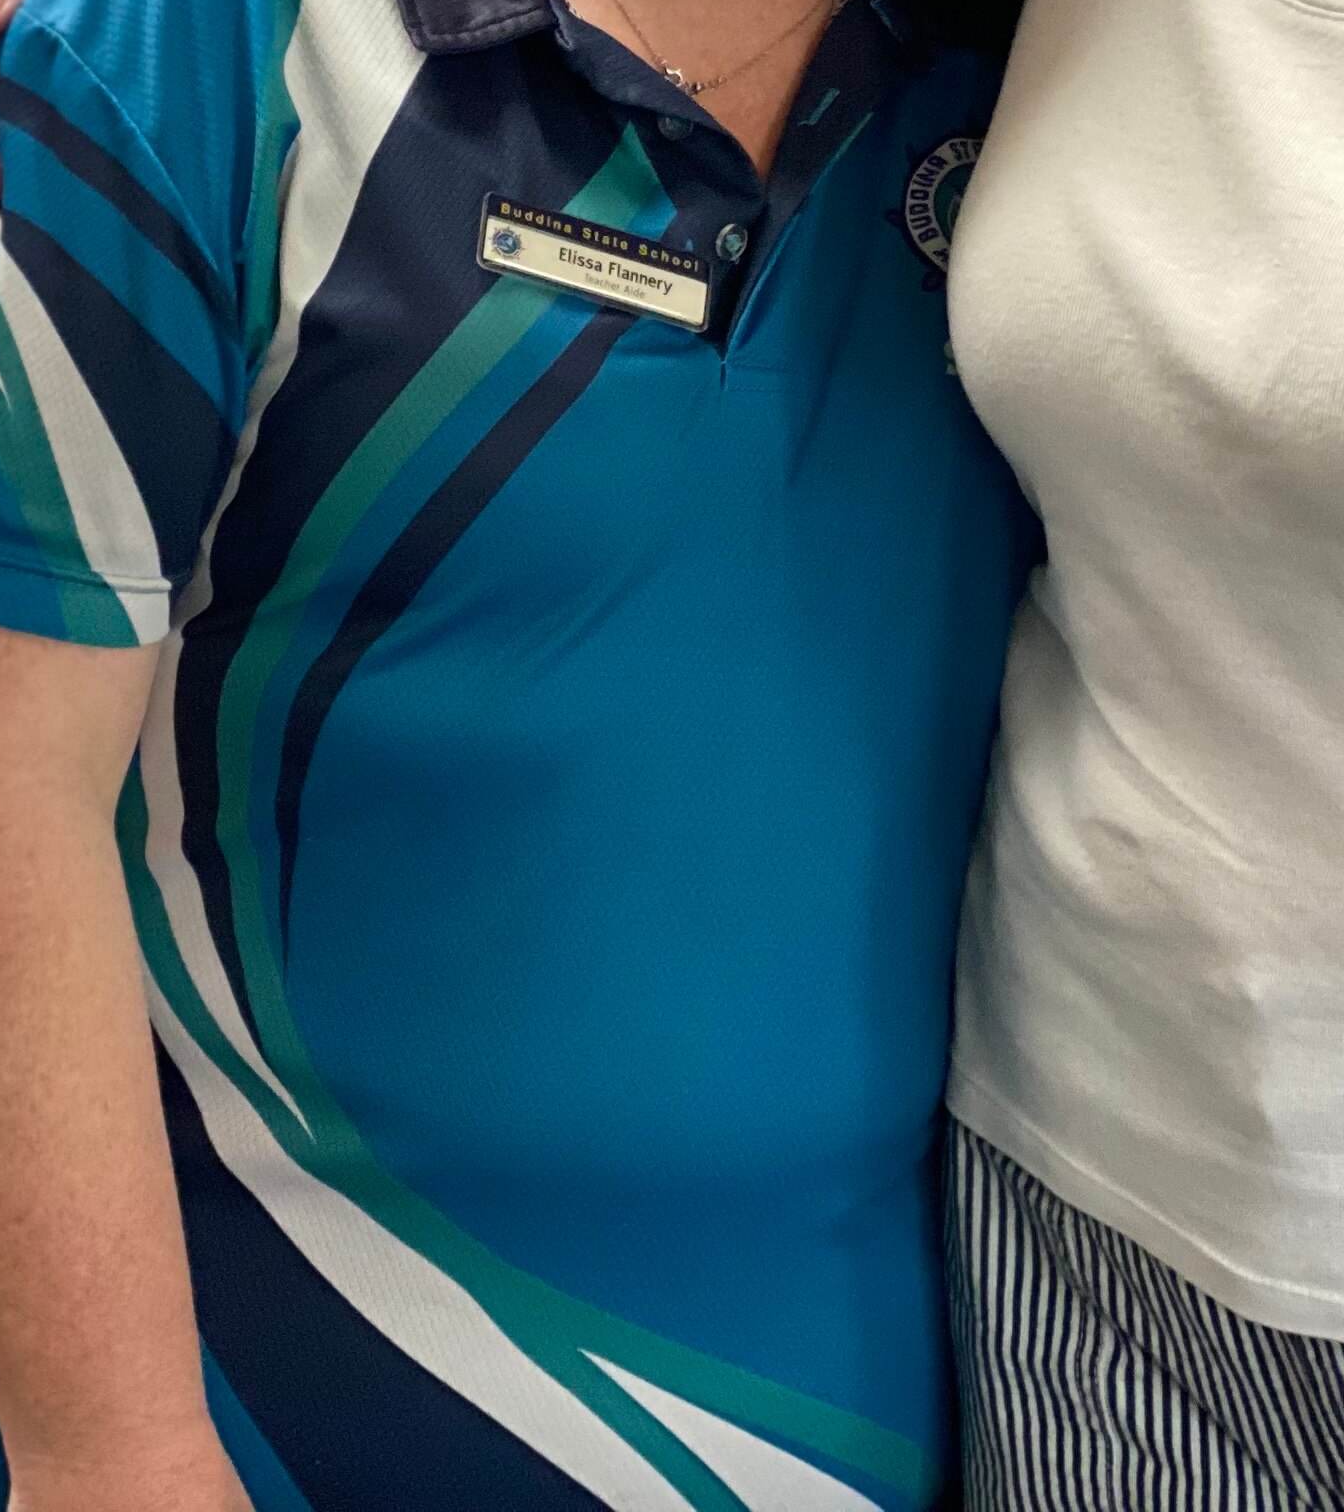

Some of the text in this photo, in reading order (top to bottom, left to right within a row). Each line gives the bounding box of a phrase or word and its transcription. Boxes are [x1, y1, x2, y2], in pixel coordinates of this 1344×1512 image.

[909, 155, 948, 243] BUDDINA
[500, 202, 699, 273] Buddina State School
[558, 246, 674, 296] Elissa Flannery
[585, 273, 646, 300] Teacher Aide
